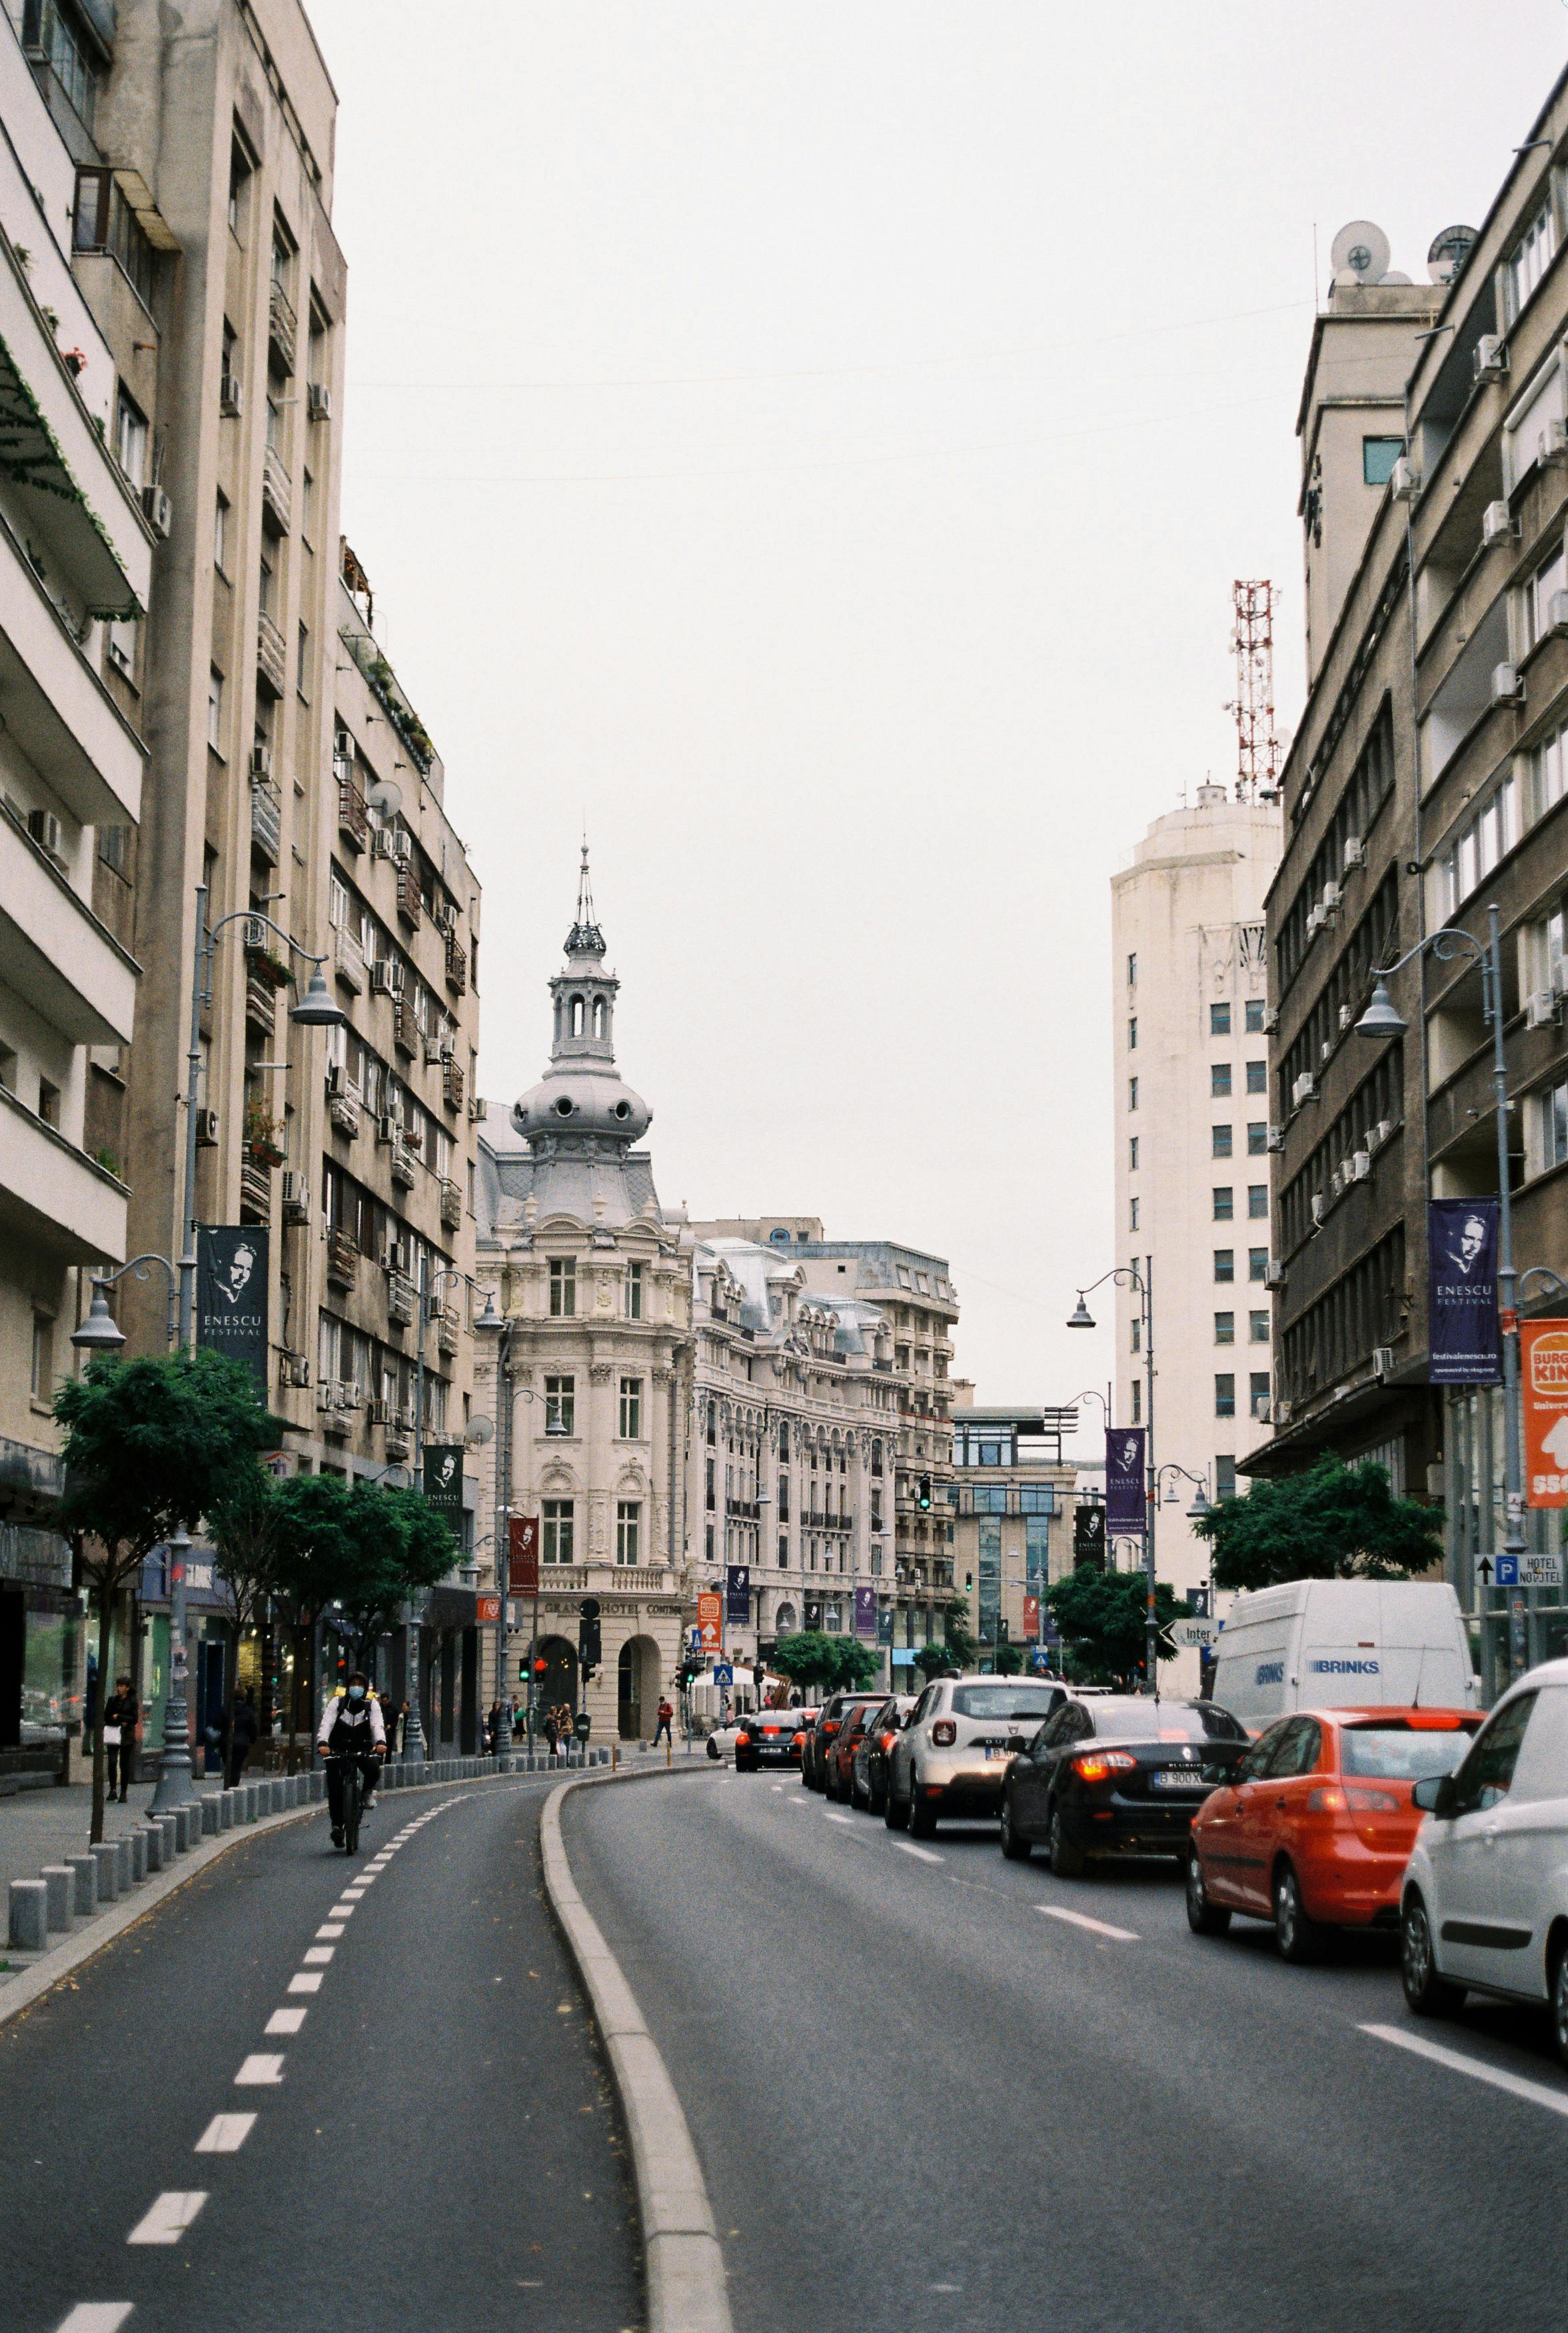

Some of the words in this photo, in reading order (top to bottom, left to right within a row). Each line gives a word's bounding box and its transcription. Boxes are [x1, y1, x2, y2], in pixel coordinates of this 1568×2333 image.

[1437, 1285, 1492, 1295] ENESCU
[205, 1315, 261, 1326] ENESCU
[1527, 1558, 1557, 1569] HOTEL
[601, 1603, 641, 1615] HOTEL
[1187, 1627, 1211, 1639] Inter
[1319, 1661, 1379, 1674] BRINKS
[994, 1749, 1000, 1758] B
[1160, 1773, 1168, 1783] B
